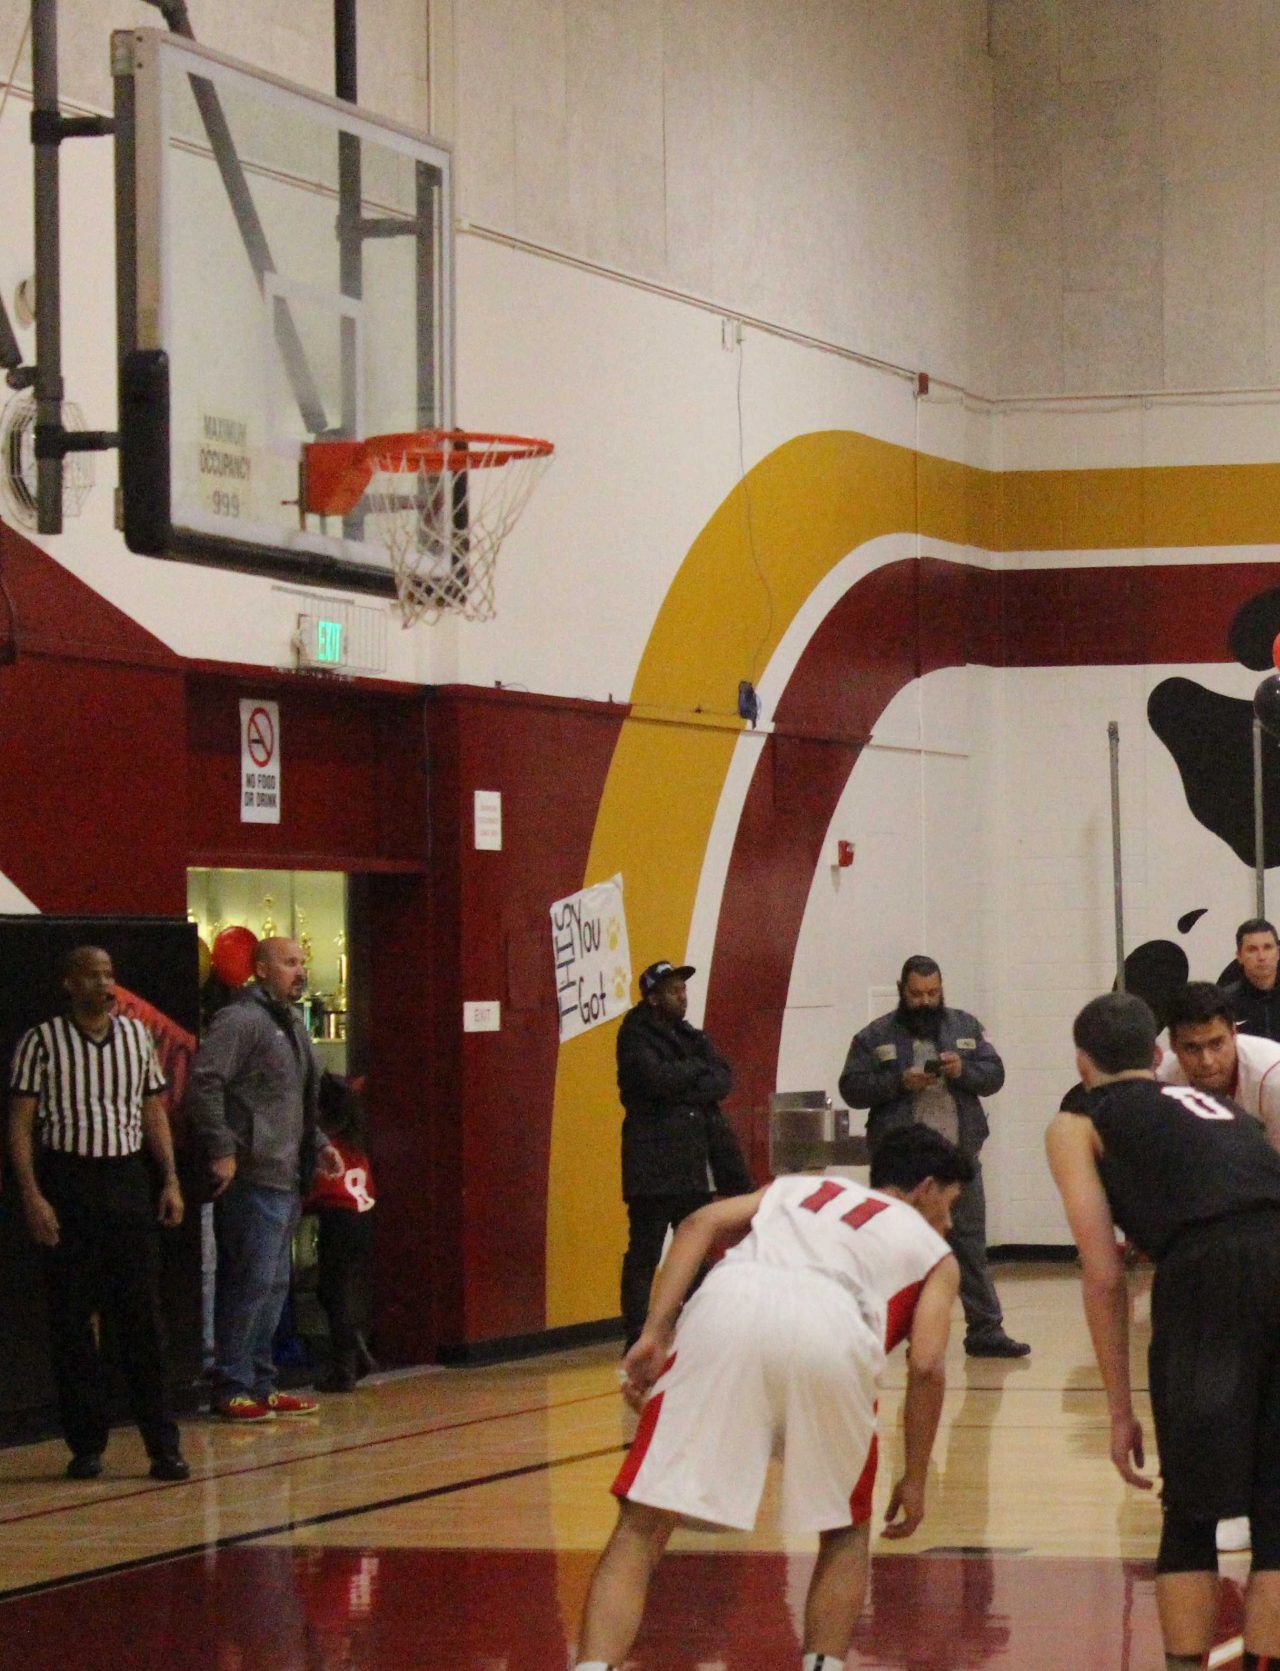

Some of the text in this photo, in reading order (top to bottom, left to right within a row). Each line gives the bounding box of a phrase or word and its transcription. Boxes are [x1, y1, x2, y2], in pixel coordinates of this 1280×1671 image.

[318, 621, 342, 662] EXIT
[245, 773, 276, 790] NO FOOD
[244, 792, 277, 809] OR DRINK
[798, 1180, 889, 1230] 11
